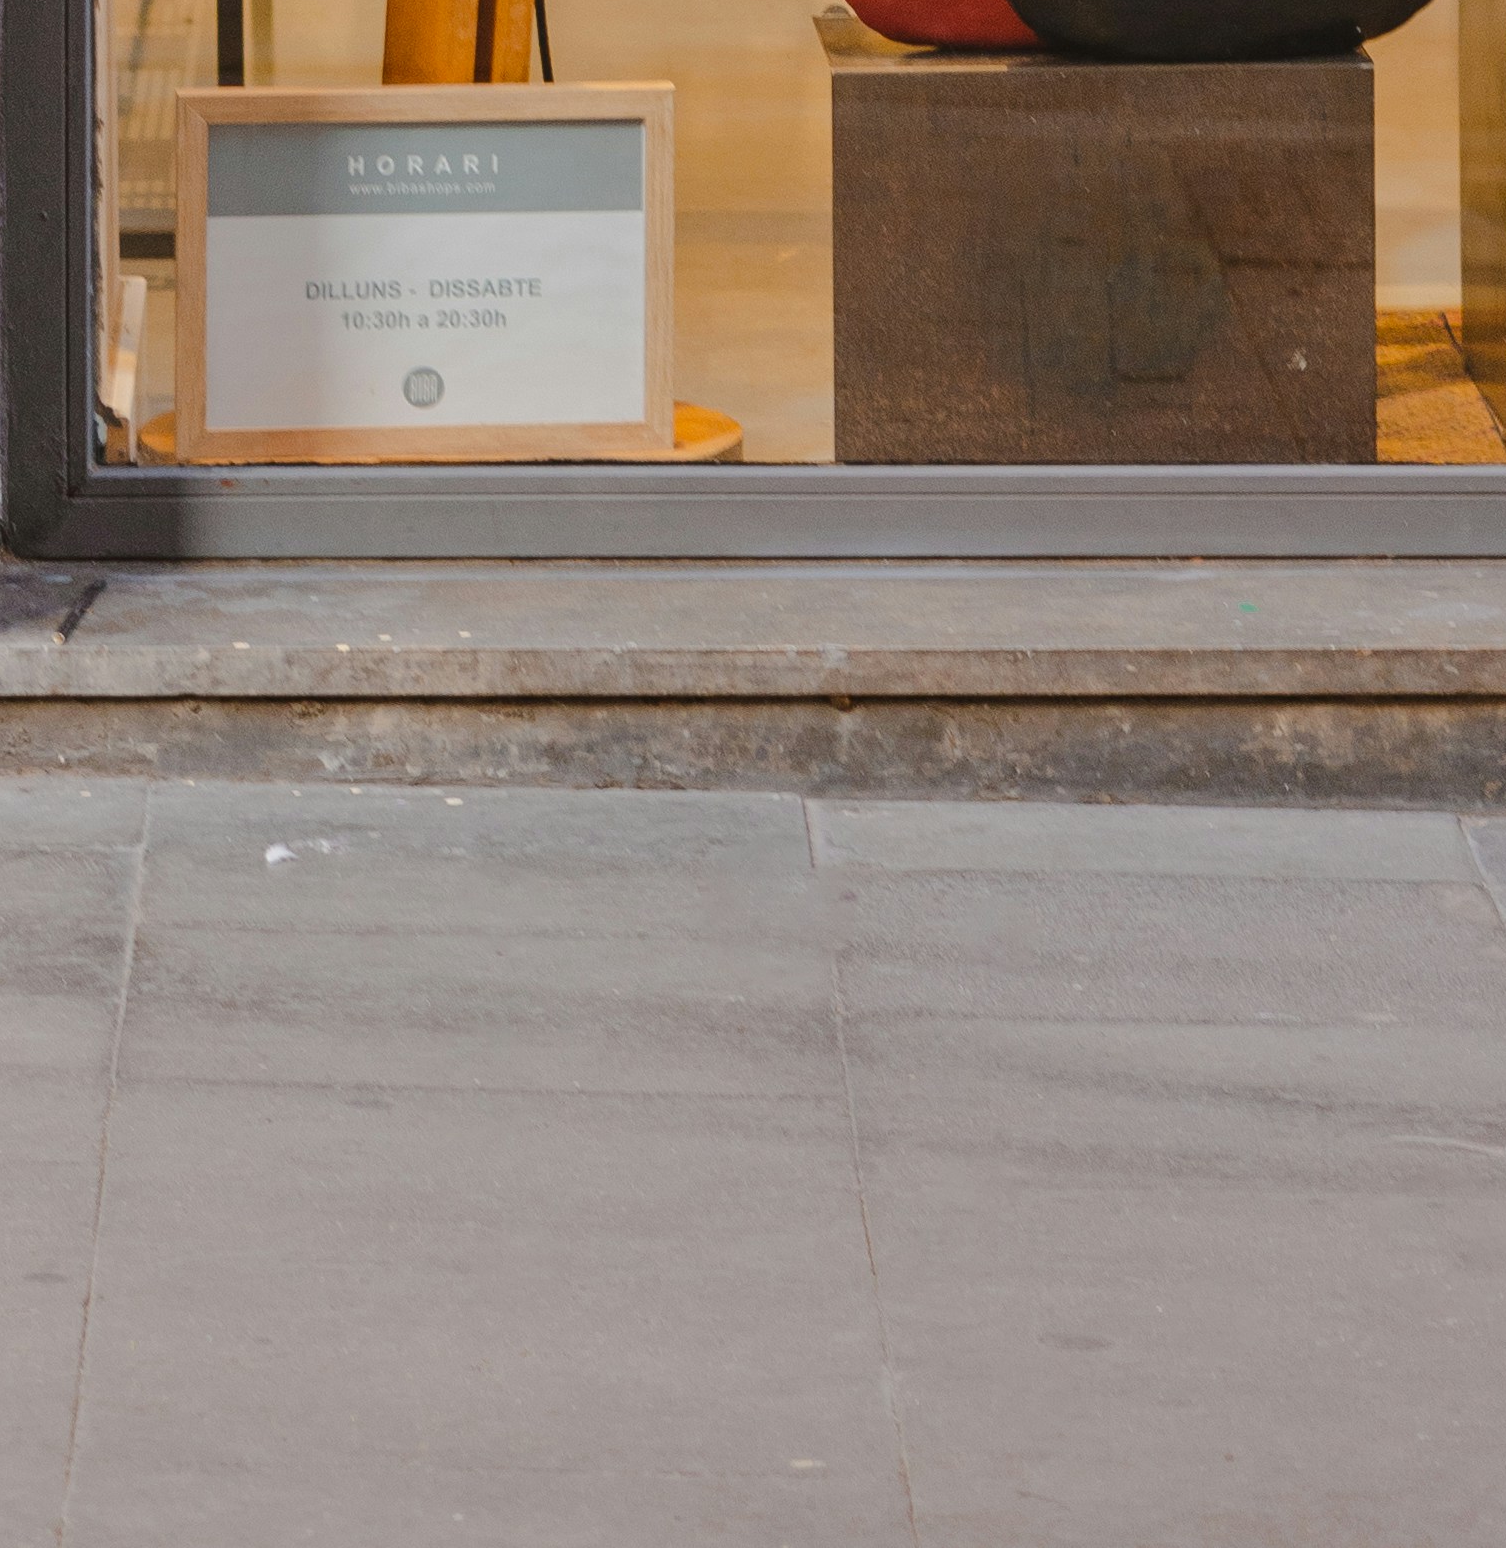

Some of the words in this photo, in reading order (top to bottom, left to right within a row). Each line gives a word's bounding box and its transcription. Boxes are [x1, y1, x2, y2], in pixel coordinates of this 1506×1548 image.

[347, 154, 499, 176] HORARI
[306, 281, 402, 300] DILLUNS
[429, 278, 543, 298] DISSABTE
[342, 311, 411, 330] 10:30h
[417, 315, 429, 329] a
[436, 309, 507, 328] 20:30h
